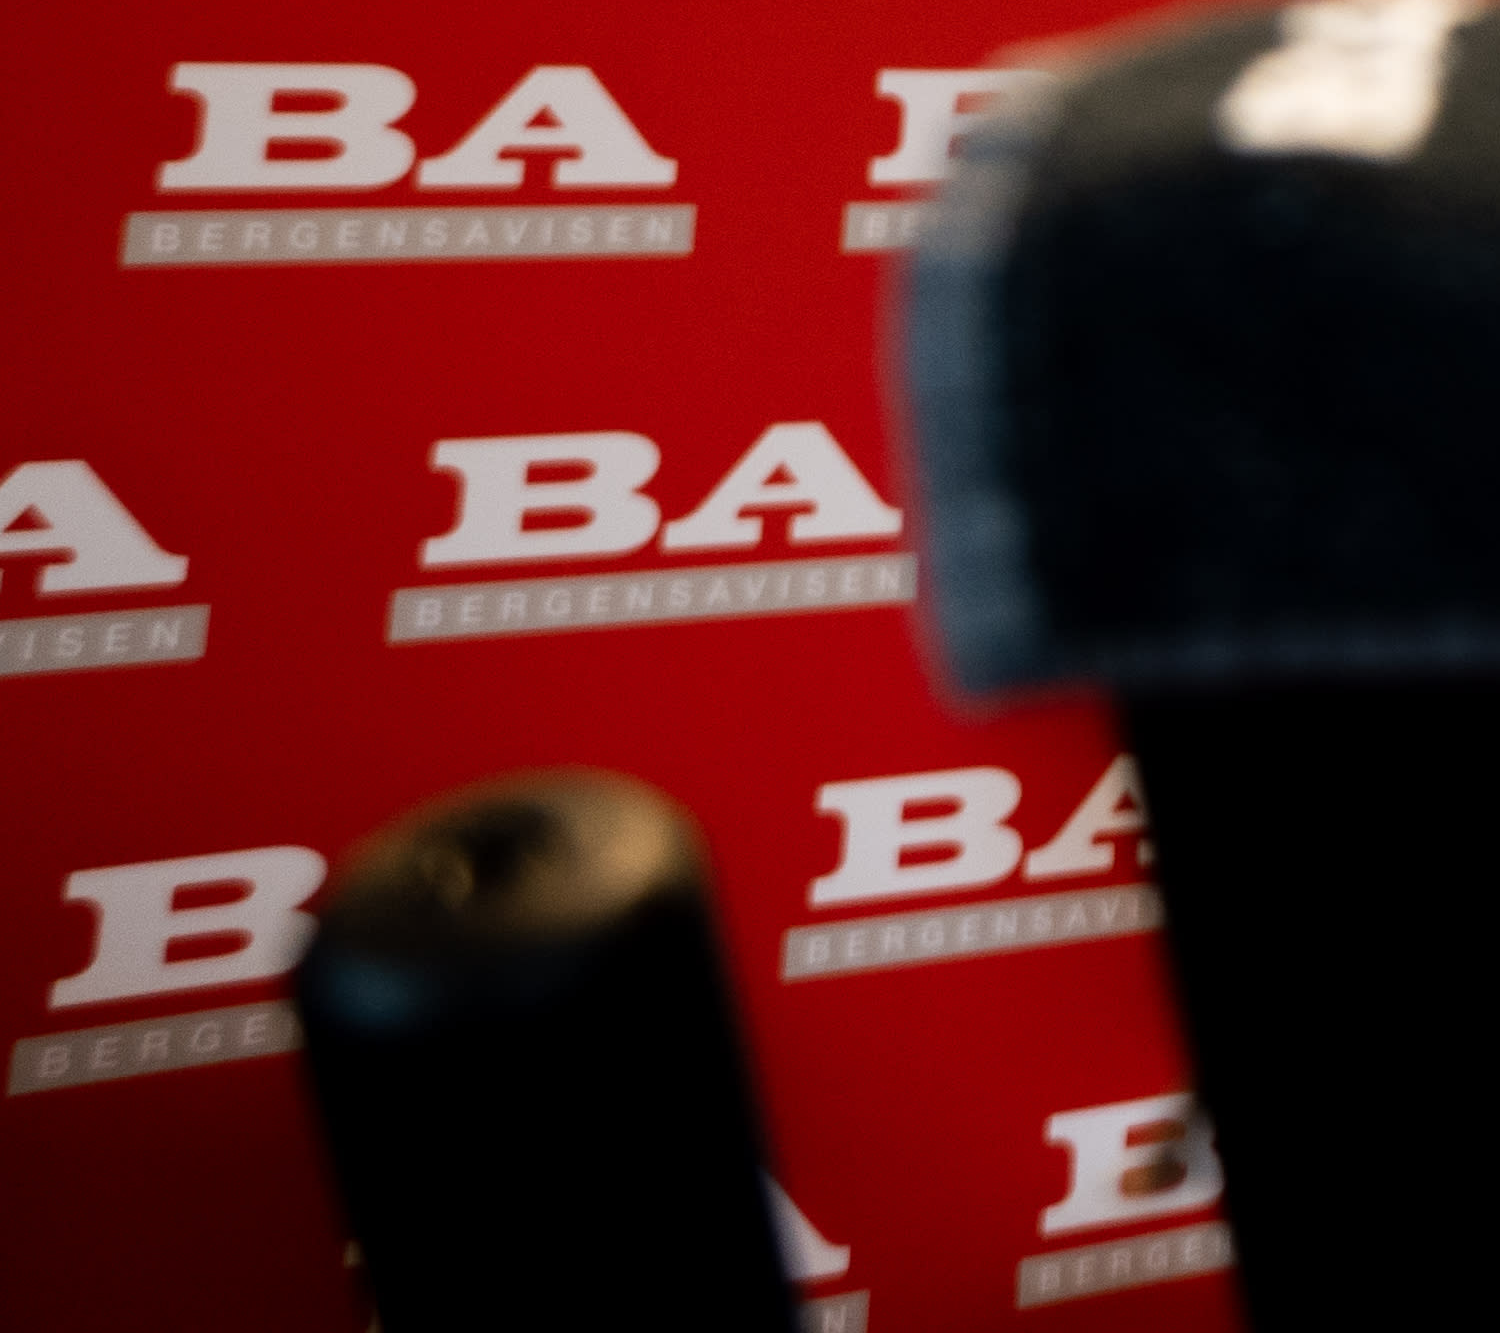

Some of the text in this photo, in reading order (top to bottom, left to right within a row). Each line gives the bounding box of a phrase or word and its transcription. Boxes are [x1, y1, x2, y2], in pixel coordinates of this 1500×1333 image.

[155, 61, 679, 192] BA
[150, 212, 674, 254] BERGENSAVISEN
[0, 459, 189, 598] A
[418, 420, 905, 570] BA
[414, 561, 904, 631] BERGENSAVISEN
[47, 844, 329, 1012] B
[808, 893, 1140, 967] BERGENSAVI
[1036, 1091, 1226, 1240] B
